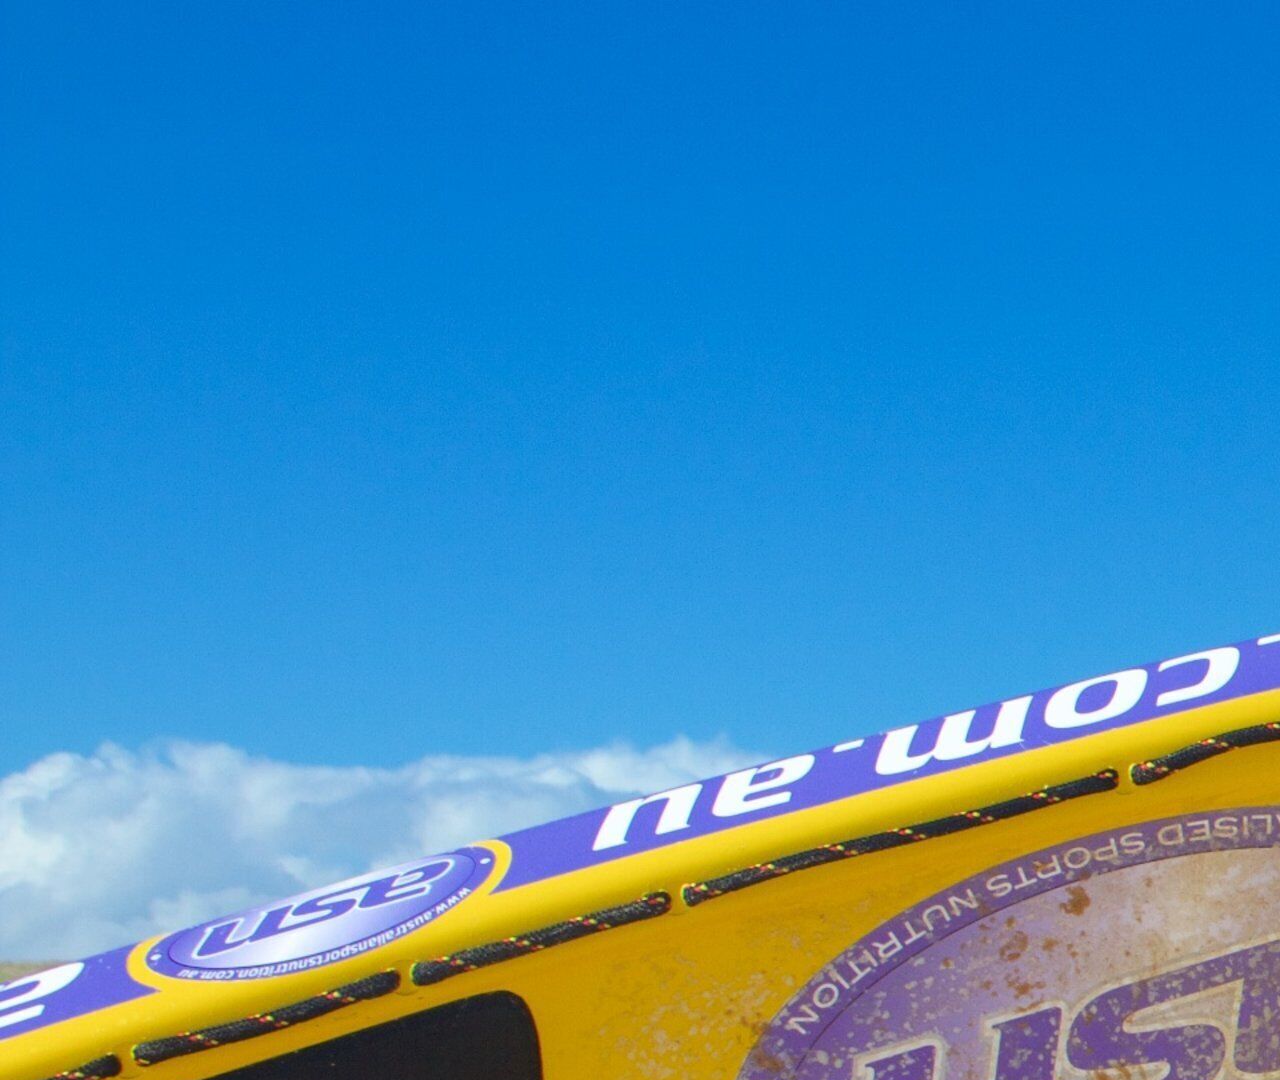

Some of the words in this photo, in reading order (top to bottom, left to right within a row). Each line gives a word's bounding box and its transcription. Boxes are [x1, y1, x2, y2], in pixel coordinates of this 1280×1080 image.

[190, 857, 457, 961] asn
[990, 831, 1146, 899] SPORTS
[787, 888, 990, 1036] NUTRITION
